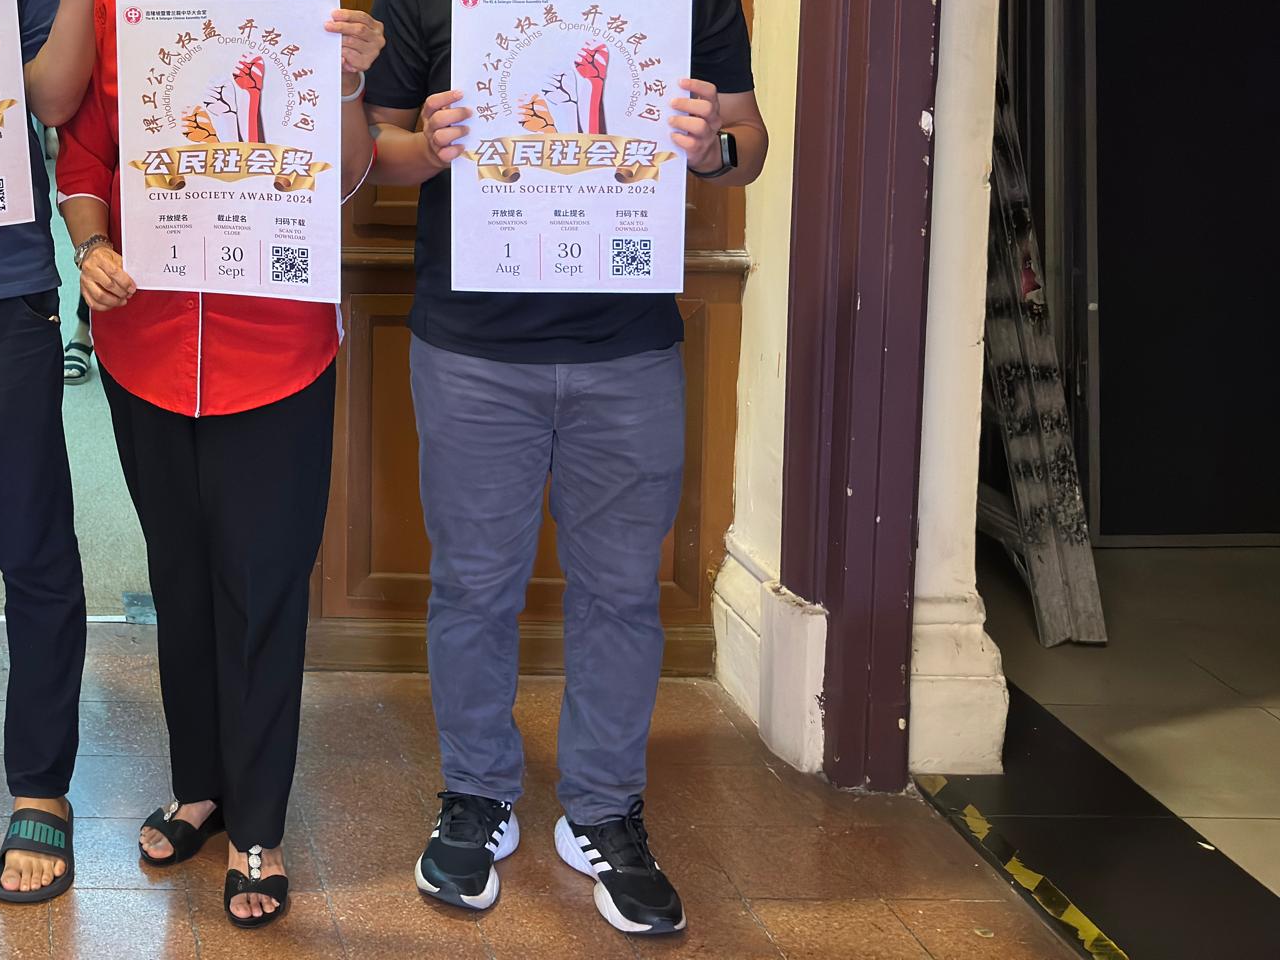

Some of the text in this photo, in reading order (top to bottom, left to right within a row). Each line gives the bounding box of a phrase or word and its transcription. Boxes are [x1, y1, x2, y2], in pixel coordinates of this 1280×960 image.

[497, 30, 543, 117] Upholding Civil Rights
[559, 22, 641, 117] Opening Up Democratic Space
[161, 44, 202, 129] Upholding Civil Rights
[217, 36, 295, 127] Opening Up Democratic Space
[475, 140, 657, 167] 公民社会奖
[142, 148, 313, 177] 公民社会奖
[481, 185, 656, 194] CIVIL SOCIETY AWARD 2024
[149, 192, 312, 204] CIVIL SOCIETY AWARD 2024
[159, 214, 188, 222] 开放提名
[217, 214, 247, 223] 截止提名
[492, 209, 523, 217] 开放提名
[554, 209, 586, 217] 截止提名
[616, 210, 648, 218] 扫码下载
[275, 218, 306, 226] 扫码下载
[171, 245, 177, 259] 1
[221, 246, 243, 262] 30
[504, 243, 511, 258] 1
[557, 243, 582, 258] 30
[163, 264, 186, 276] Aug
[218, 265, 245, 277] Sept
[496, 263, 520, 276] Aug
[554, 263, 583, 276] Sept
[8, 820, 66, 849] PUMA
